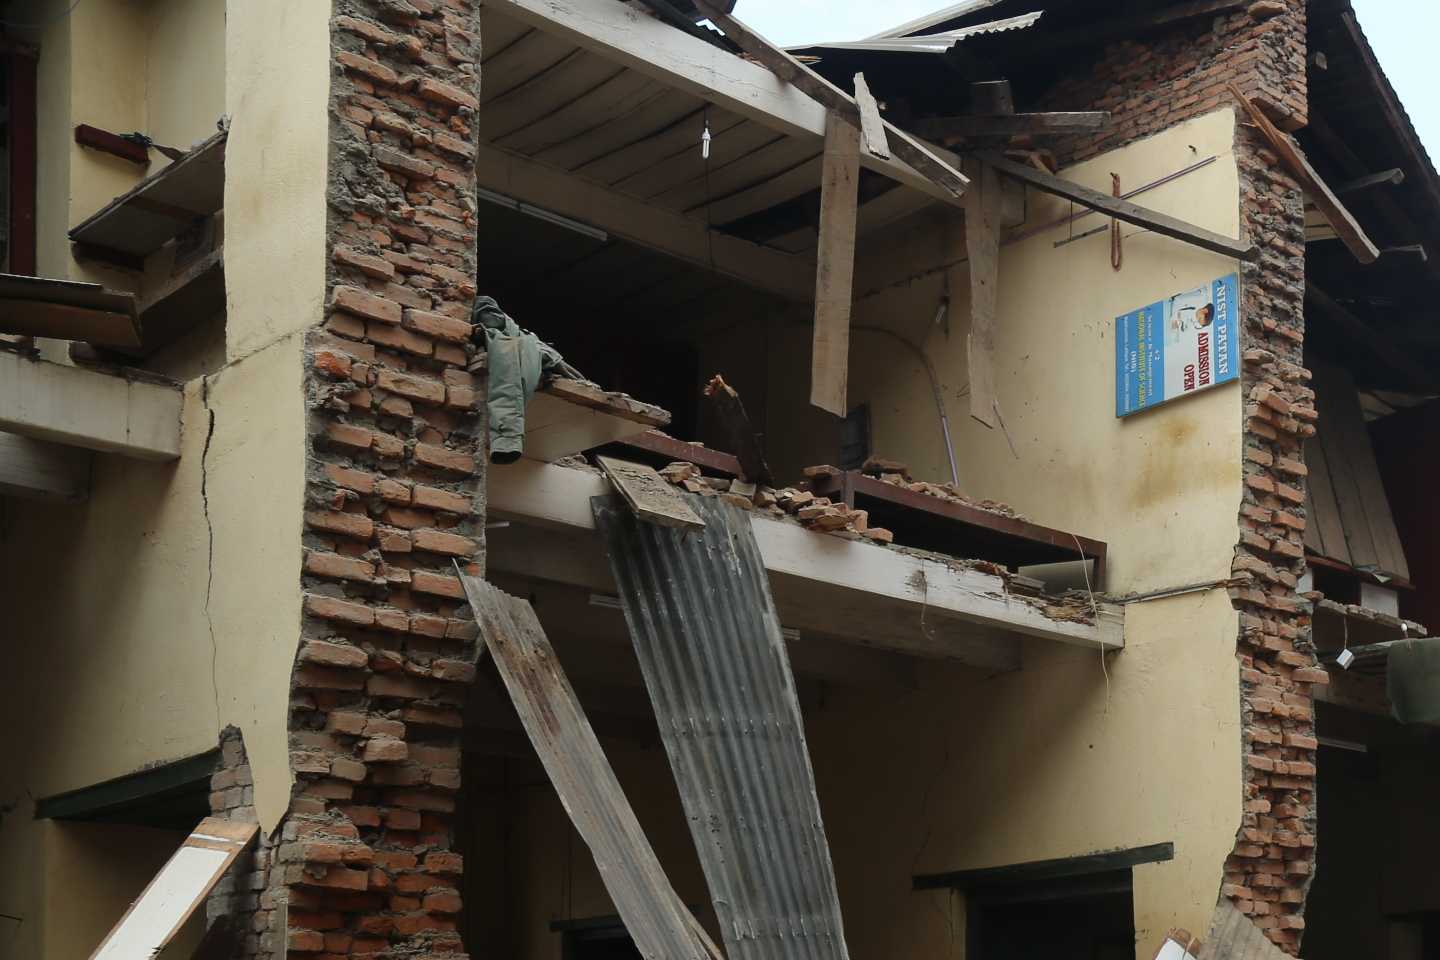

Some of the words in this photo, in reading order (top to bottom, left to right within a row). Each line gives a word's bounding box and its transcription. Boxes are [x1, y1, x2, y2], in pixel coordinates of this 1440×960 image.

[1216, 285, 1227, 321] NIST
[1198, 332, 1210, 387] ADMISSION
[1217, 324, 1228, 375] PATAN
[1184, 364, 1195, 392] OPEN
